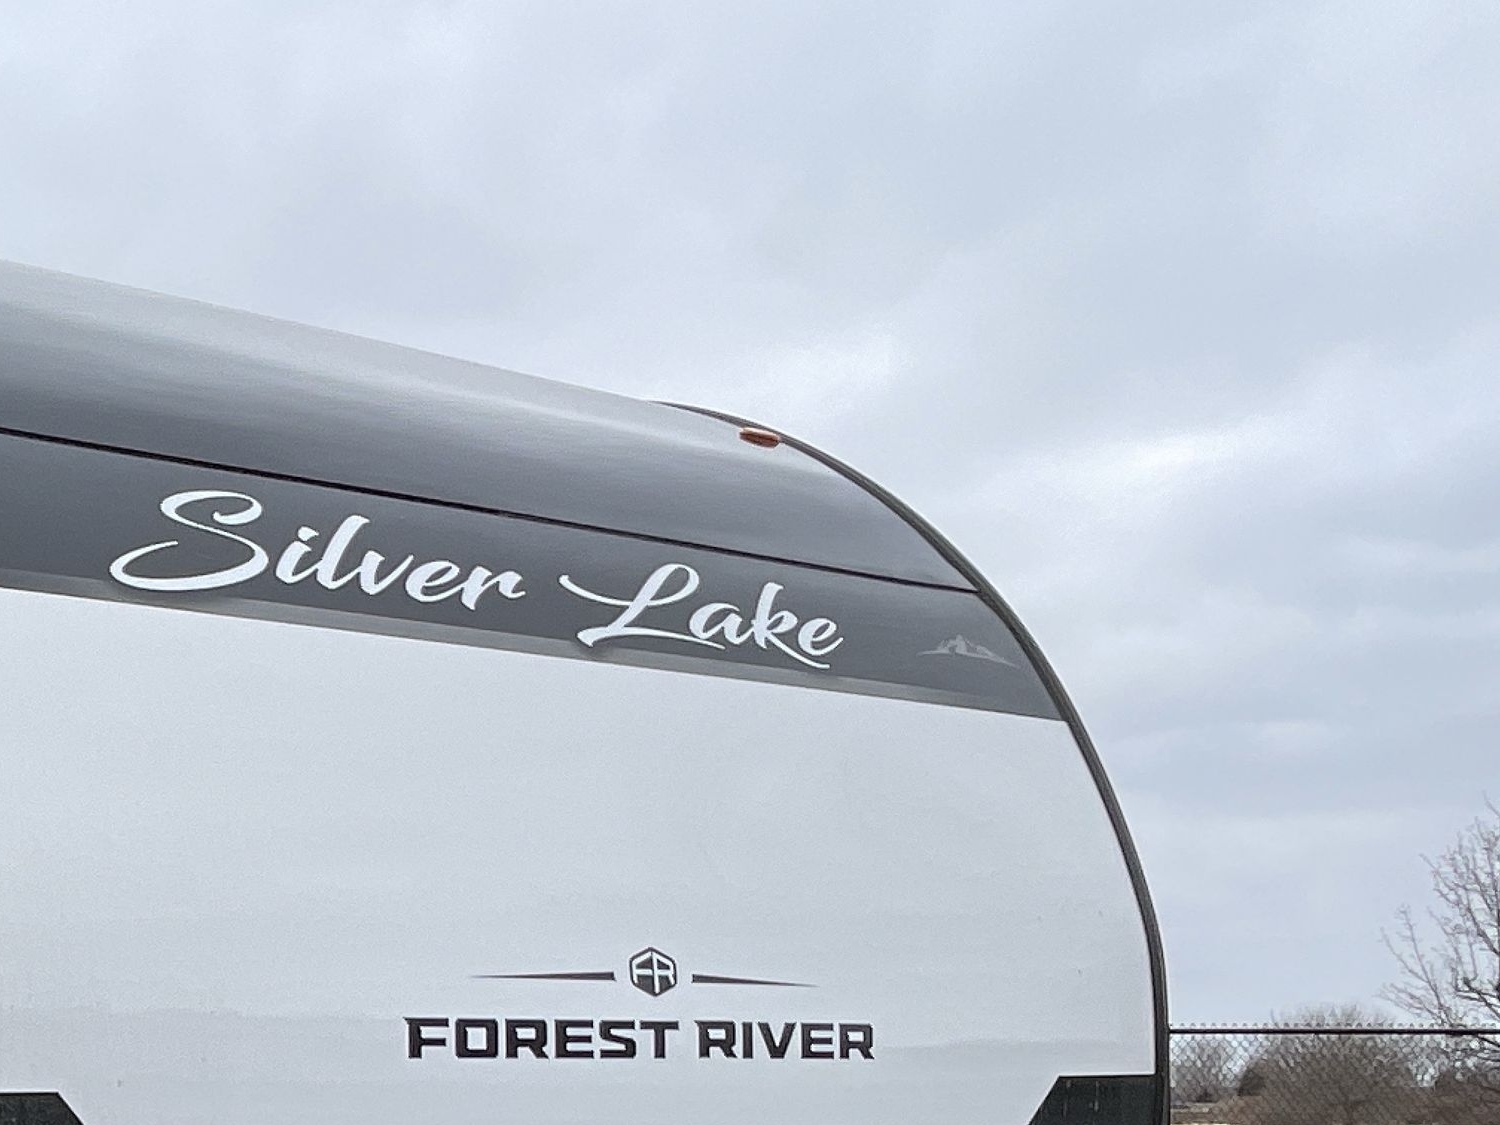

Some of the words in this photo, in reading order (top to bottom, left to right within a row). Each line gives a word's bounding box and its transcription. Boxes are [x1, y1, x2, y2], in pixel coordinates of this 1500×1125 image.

[109, 490, 526, 611] Silver
[560, 563, 844, 669] Lake
[404, 1016, 680, 1060] FOREST
[694, 1020, 875, 1060] RIVER
